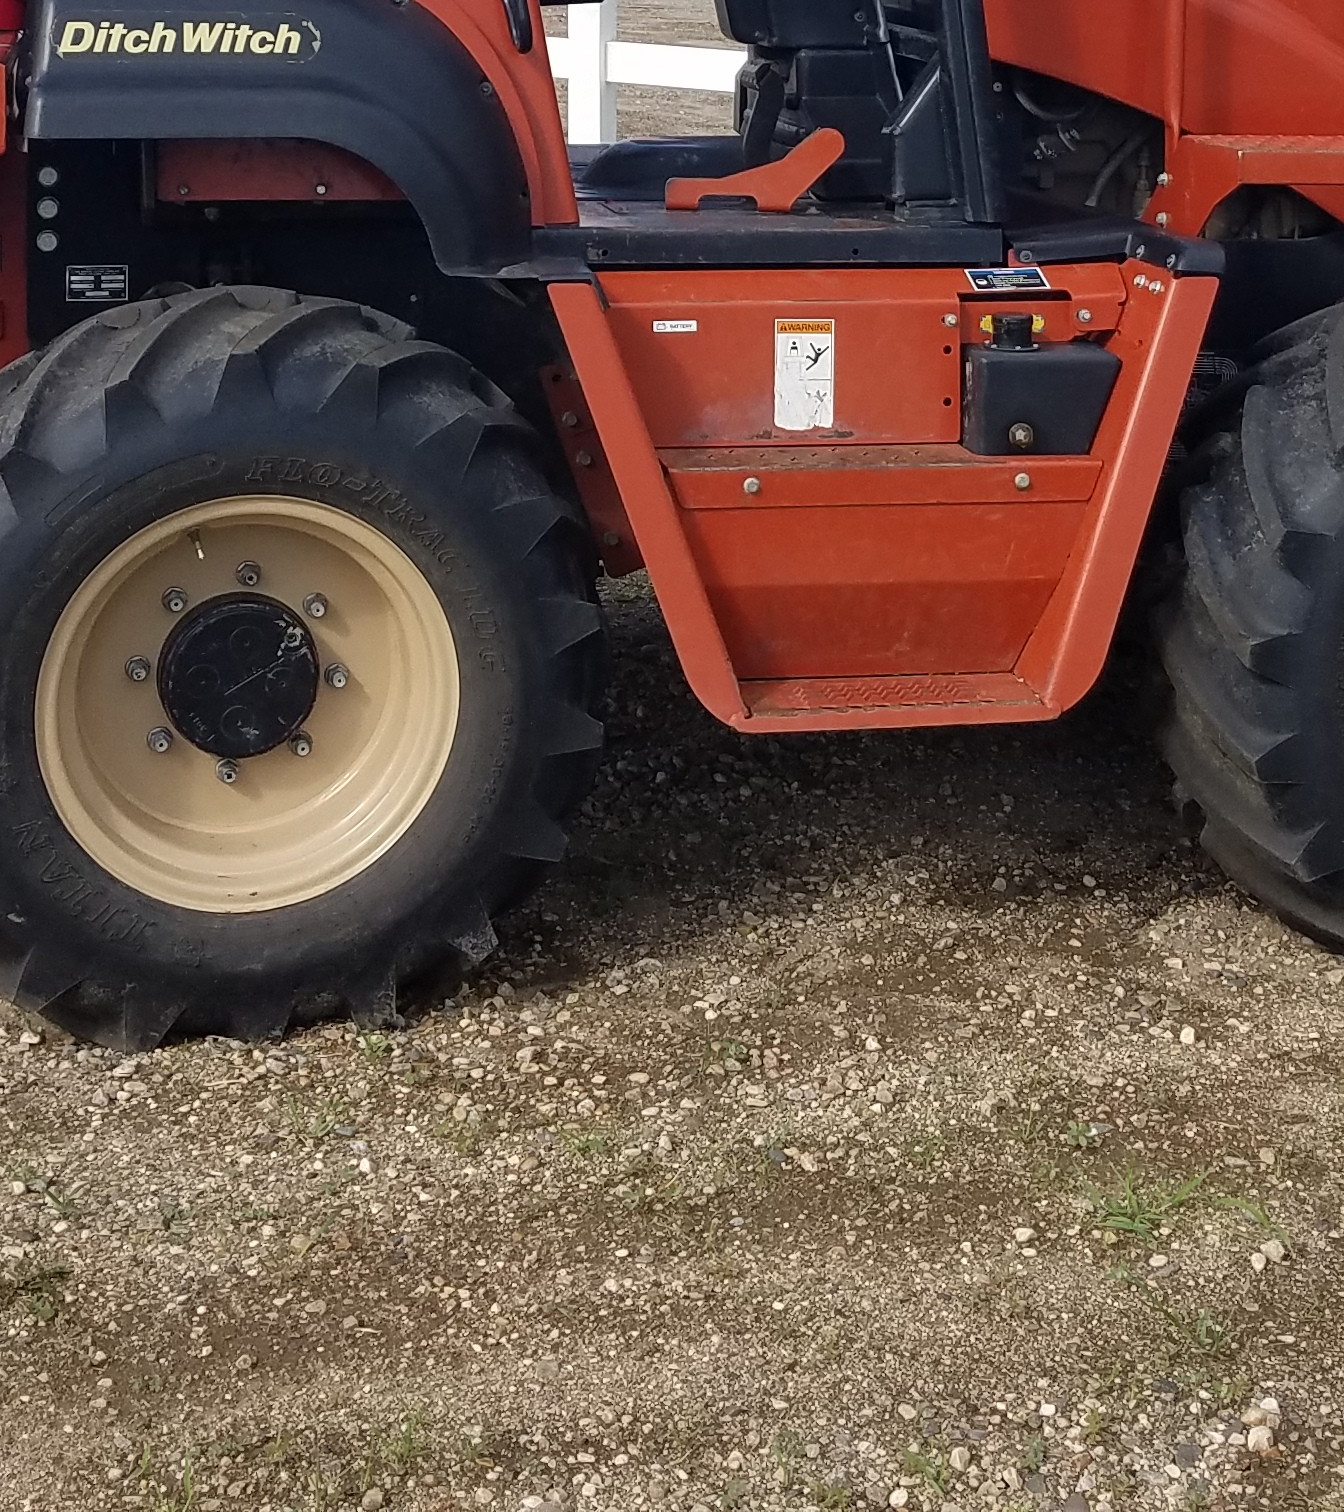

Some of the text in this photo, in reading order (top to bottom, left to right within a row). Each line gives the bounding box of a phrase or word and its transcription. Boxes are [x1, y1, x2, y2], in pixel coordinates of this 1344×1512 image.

[57, 21, 301, 54] Ditch Witch
[787, 322, 831, 332] WARNING
